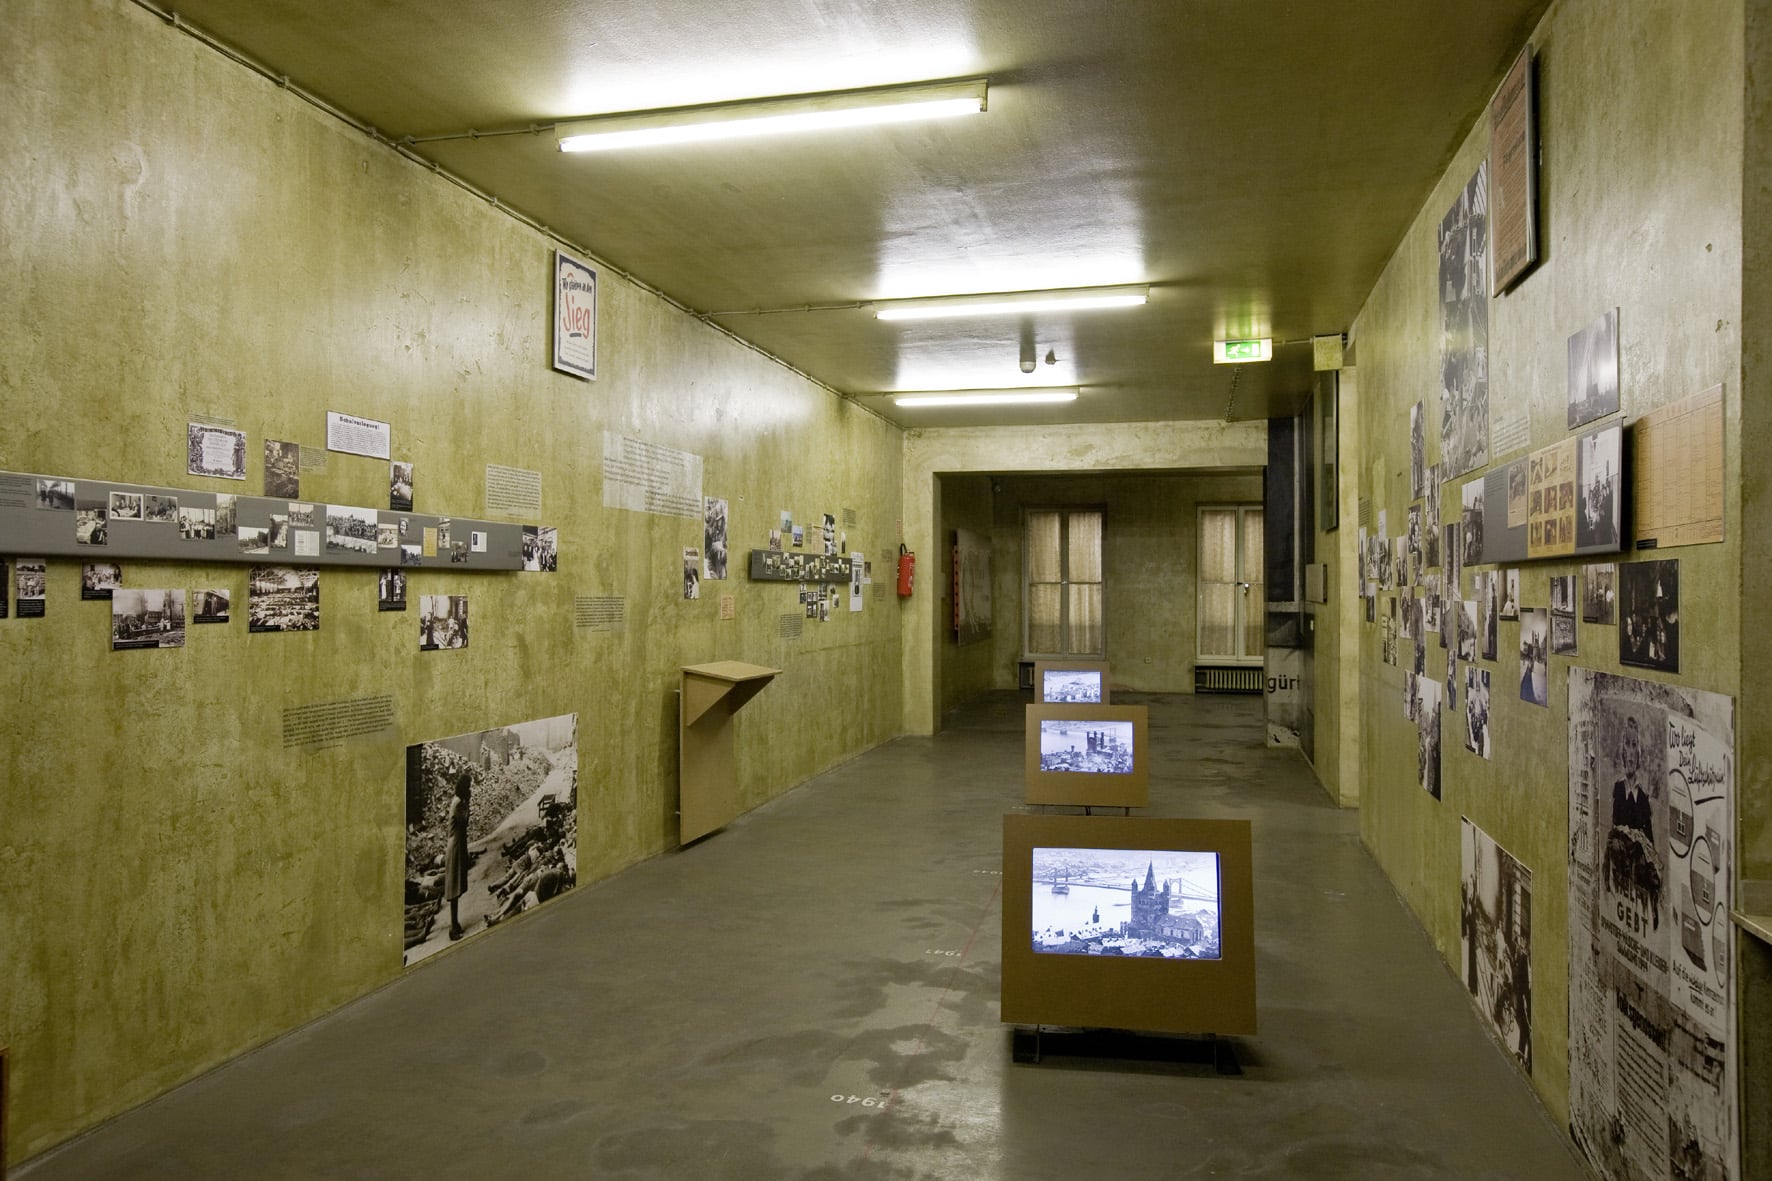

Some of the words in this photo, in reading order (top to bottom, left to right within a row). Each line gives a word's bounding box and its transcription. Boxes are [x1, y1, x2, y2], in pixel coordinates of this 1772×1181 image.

[563, 292, 590, 339] Sieg
[1617, 902, 1648, 938] GEBT
[830, 1094, 886, 1109] 1940
